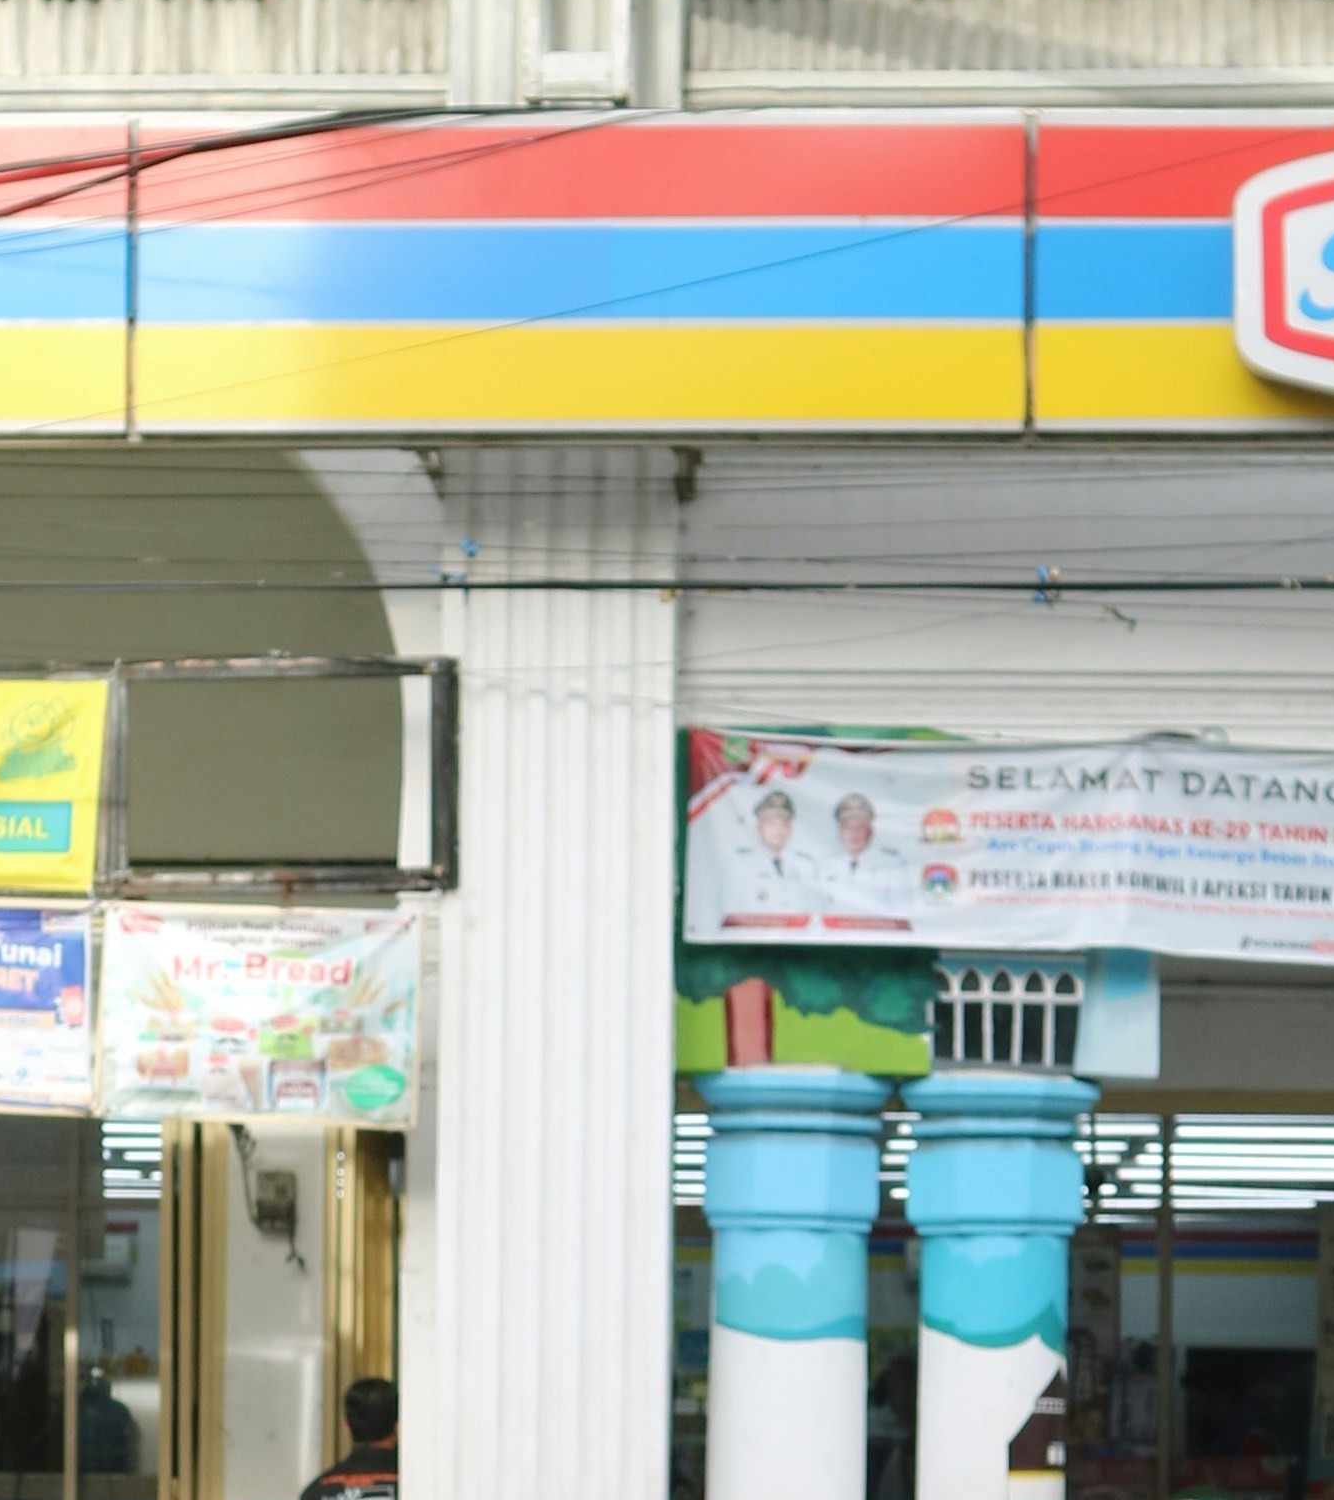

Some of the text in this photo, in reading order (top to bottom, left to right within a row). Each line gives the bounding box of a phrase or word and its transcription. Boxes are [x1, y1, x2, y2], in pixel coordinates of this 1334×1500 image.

[968, 765, 1162, 793] SELAMAT
[969, 810, 1056, 832] PESERTA
[1257, 821, 1329, 844] TAHUN
[172, 951, 353, 986] Mr. Bread
